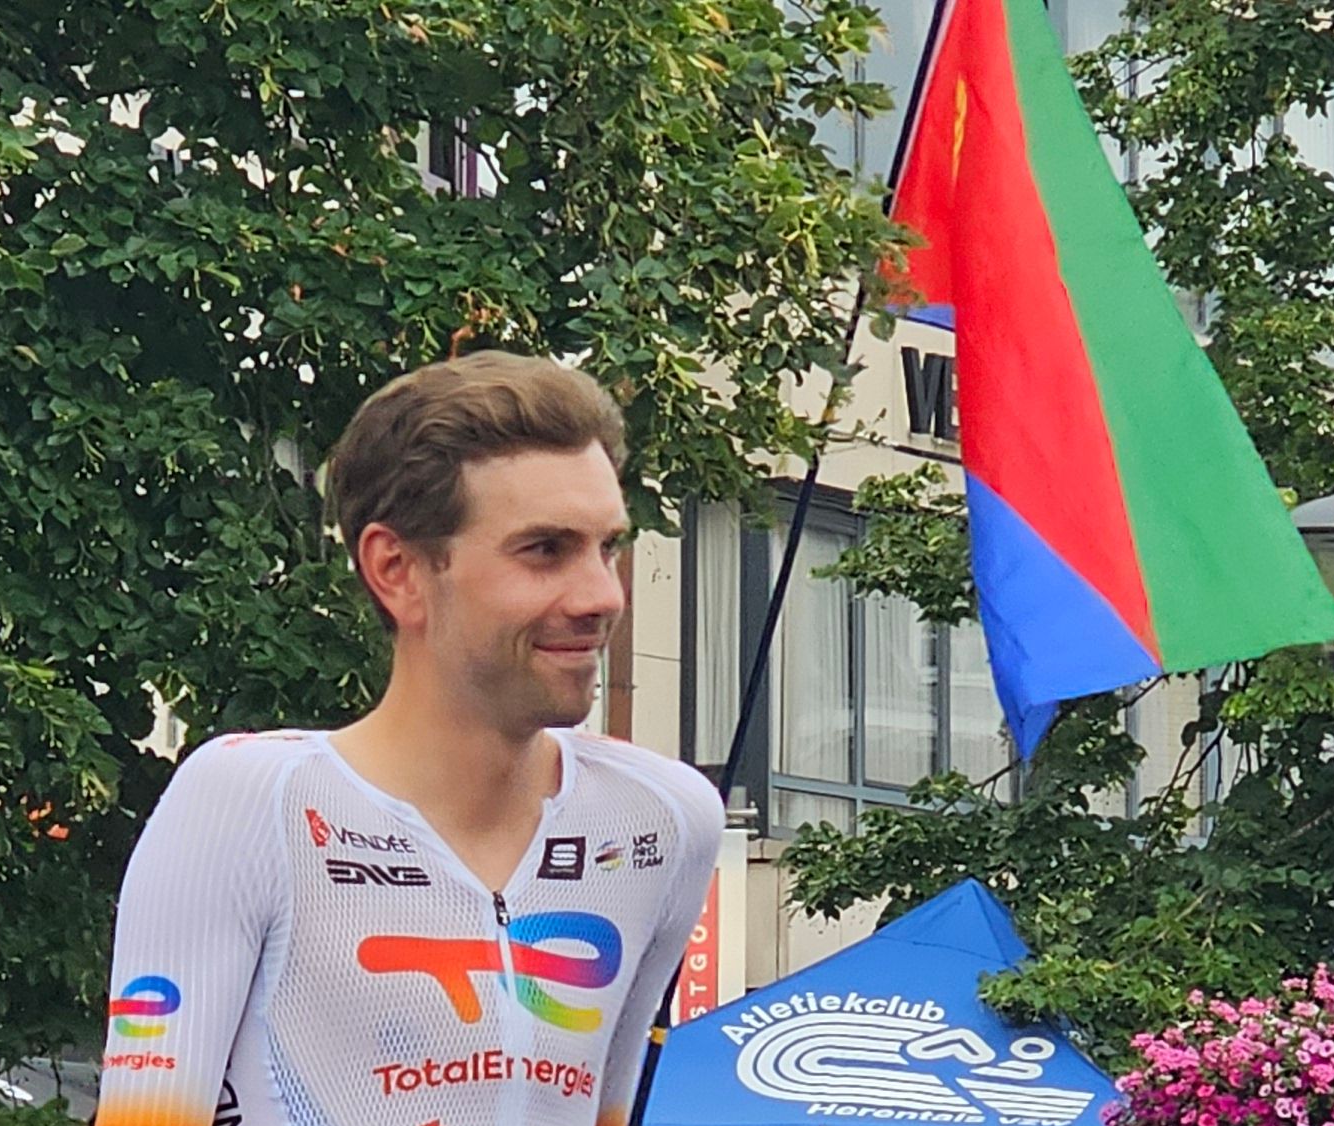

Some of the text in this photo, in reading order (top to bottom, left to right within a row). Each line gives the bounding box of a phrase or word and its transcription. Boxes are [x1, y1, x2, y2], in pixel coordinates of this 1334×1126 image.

[329, 822, 417, 854] VENDÉE
[720, 992, 946, 1046] Atletiekclub
[372, 1049, 596, 1099] TotalEnergies
